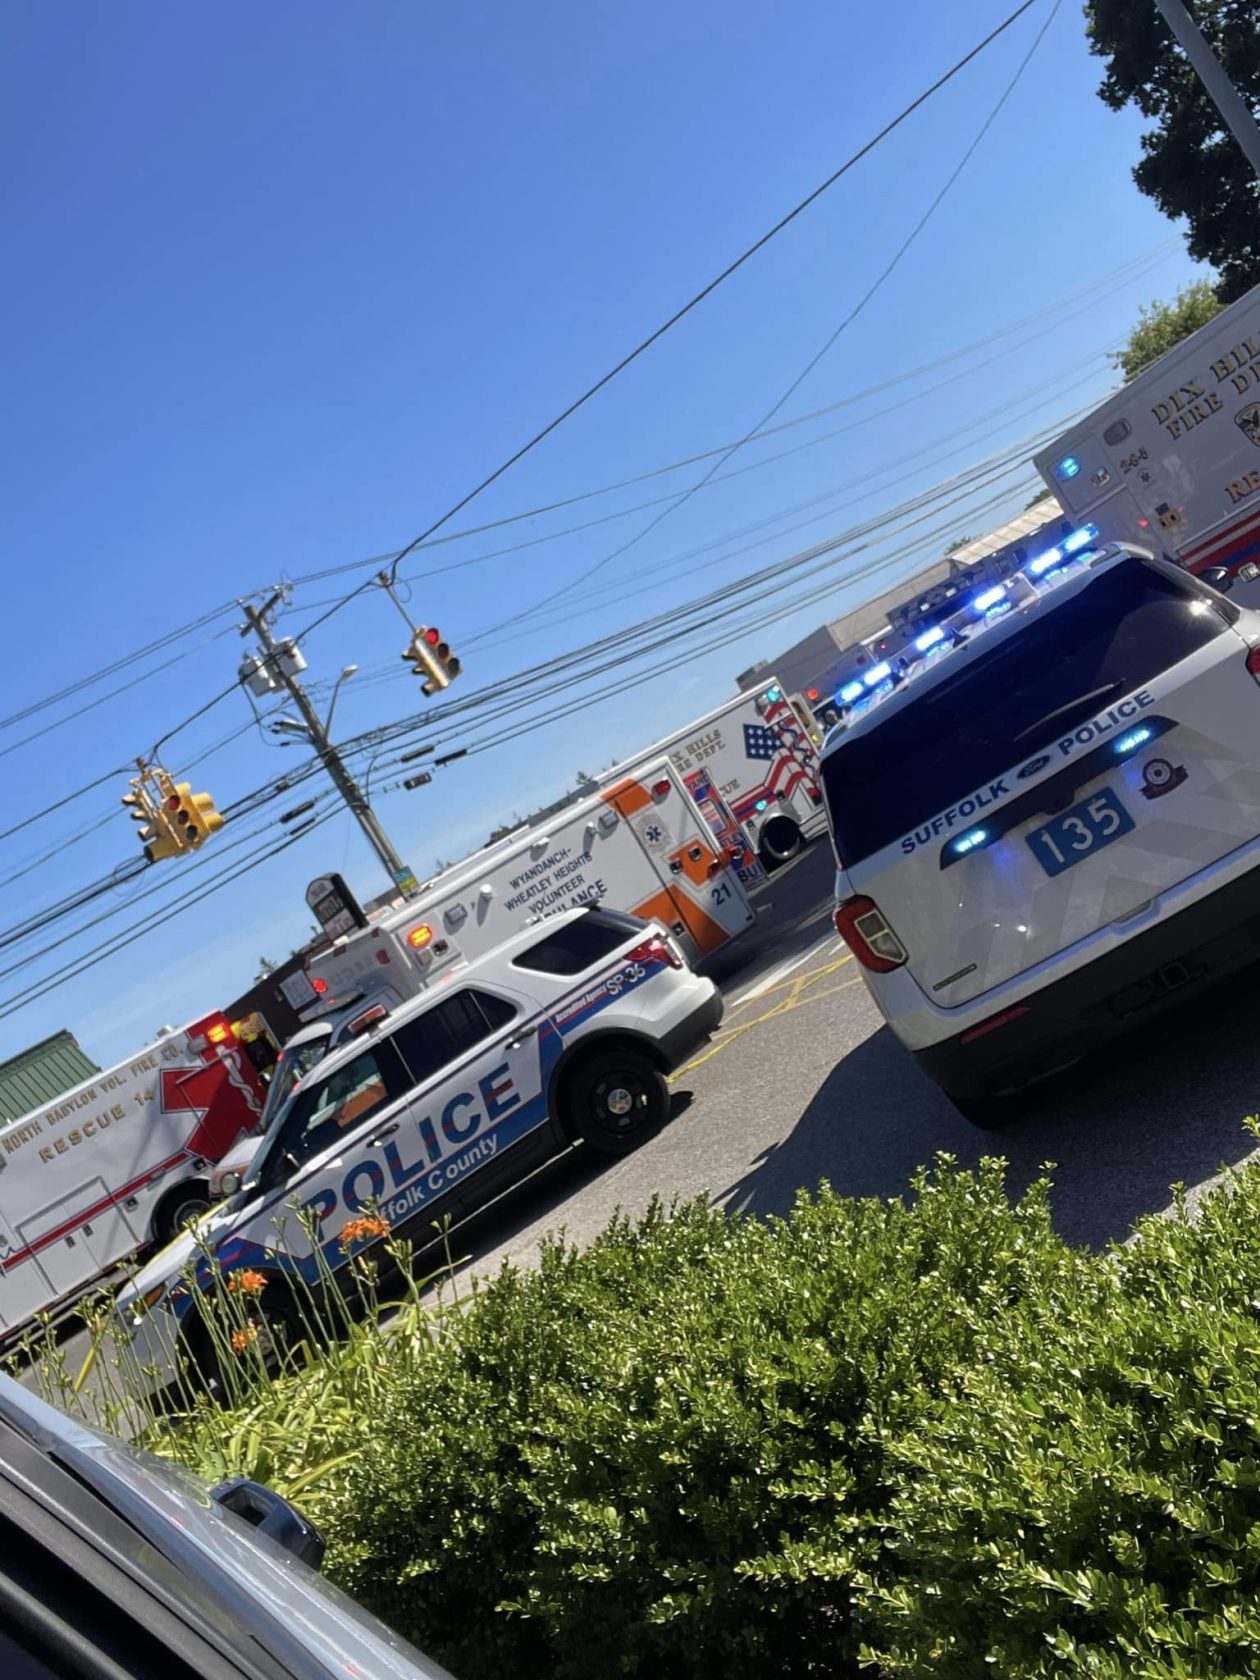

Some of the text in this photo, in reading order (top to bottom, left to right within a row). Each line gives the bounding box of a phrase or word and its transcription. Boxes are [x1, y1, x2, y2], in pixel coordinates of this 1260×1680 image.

[1152, 376, 1207, 425] DIX
[1166, 392, 1224, 441] FIRE
[685, 729, 721, 756] HILLS
[901, 778, 1011, 855] SUFFOLK
[1058, 689, 1156, 756] POLICE
[1041, 796, 1121, 864] 135
[504, 851, 594, 912] WHEATLEY HEIGHTS
[528, 874, 585, 915] VOLUNTEER
[711, 883, 732, 906] 21
[2, 1120, 43, 1154] NORTH
[46, 1088, 98, 1126] BABYLON
[130, 1055, 159, 1077] FIRE
[38, 1103, 126, 1164] RESCUE
[301, 1062, 521, 1243] POLICE
[428, 1134, 499, 1191] County
